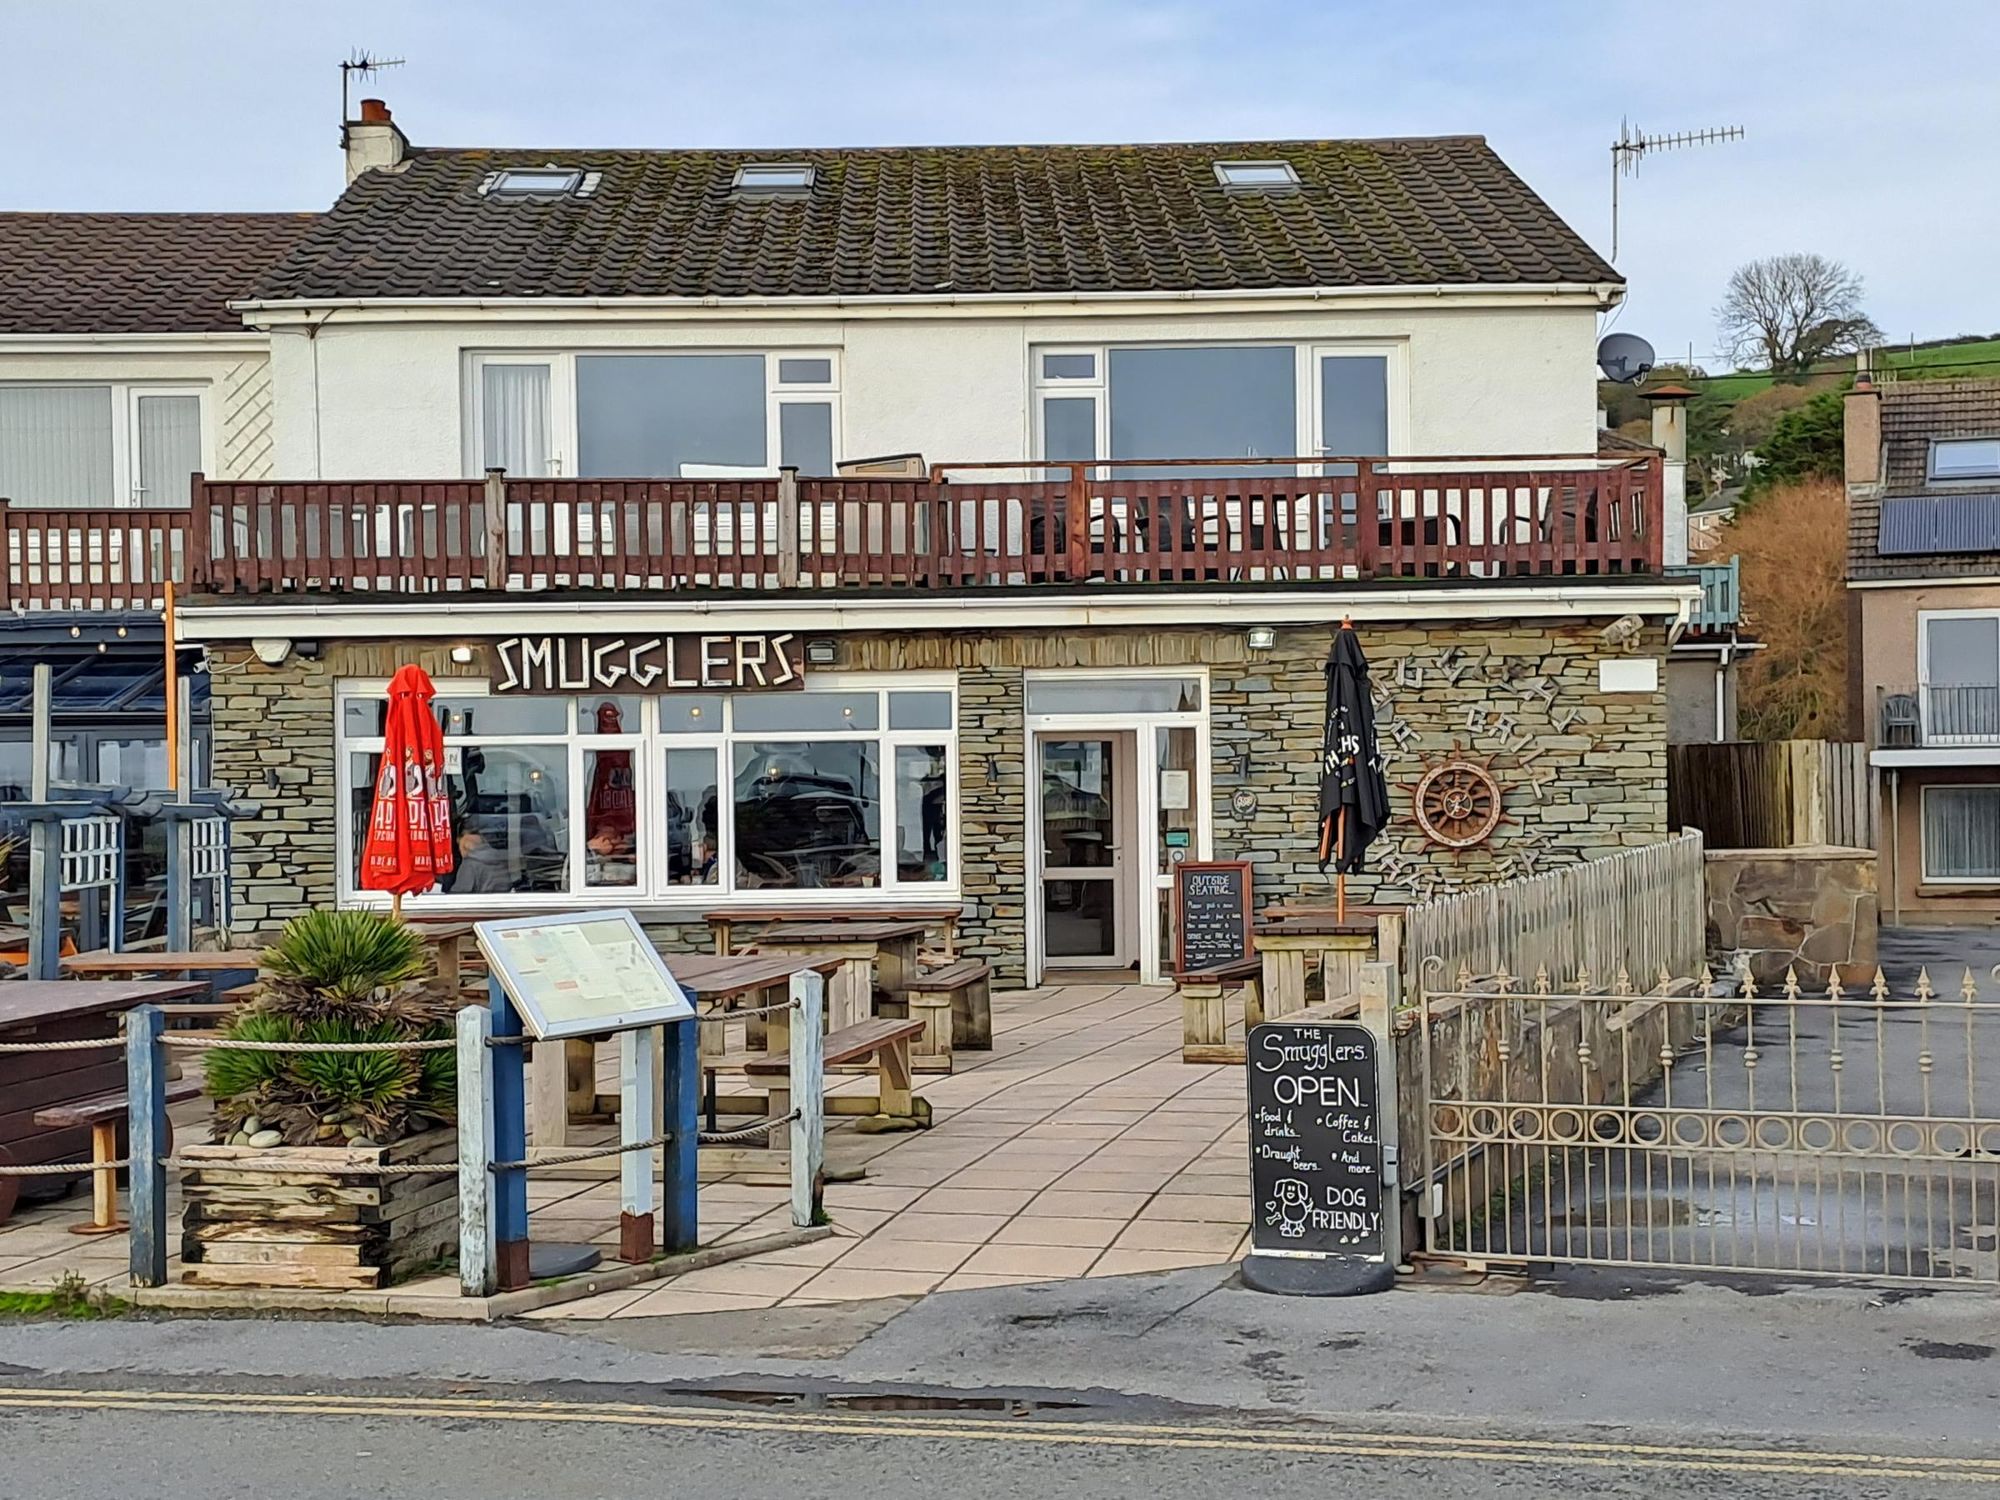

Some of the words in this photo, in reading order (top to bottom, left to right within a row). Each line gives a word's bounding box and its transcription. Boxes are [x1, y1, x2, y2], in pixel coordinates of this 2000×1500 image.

[496, 633, 796, 691] SMUGGLERS
[1293, 1028, 1321, 1040] THE
[1325, 1112, 1360, 1130] Coffee
[1262, 1144, 1303, 1162] Draught
[1340, 1150, 1360, 1164] And
[1326, 1186, 1367, 1207] DOG
[1312, 1210, 1380, 1232] FRIENDLY
